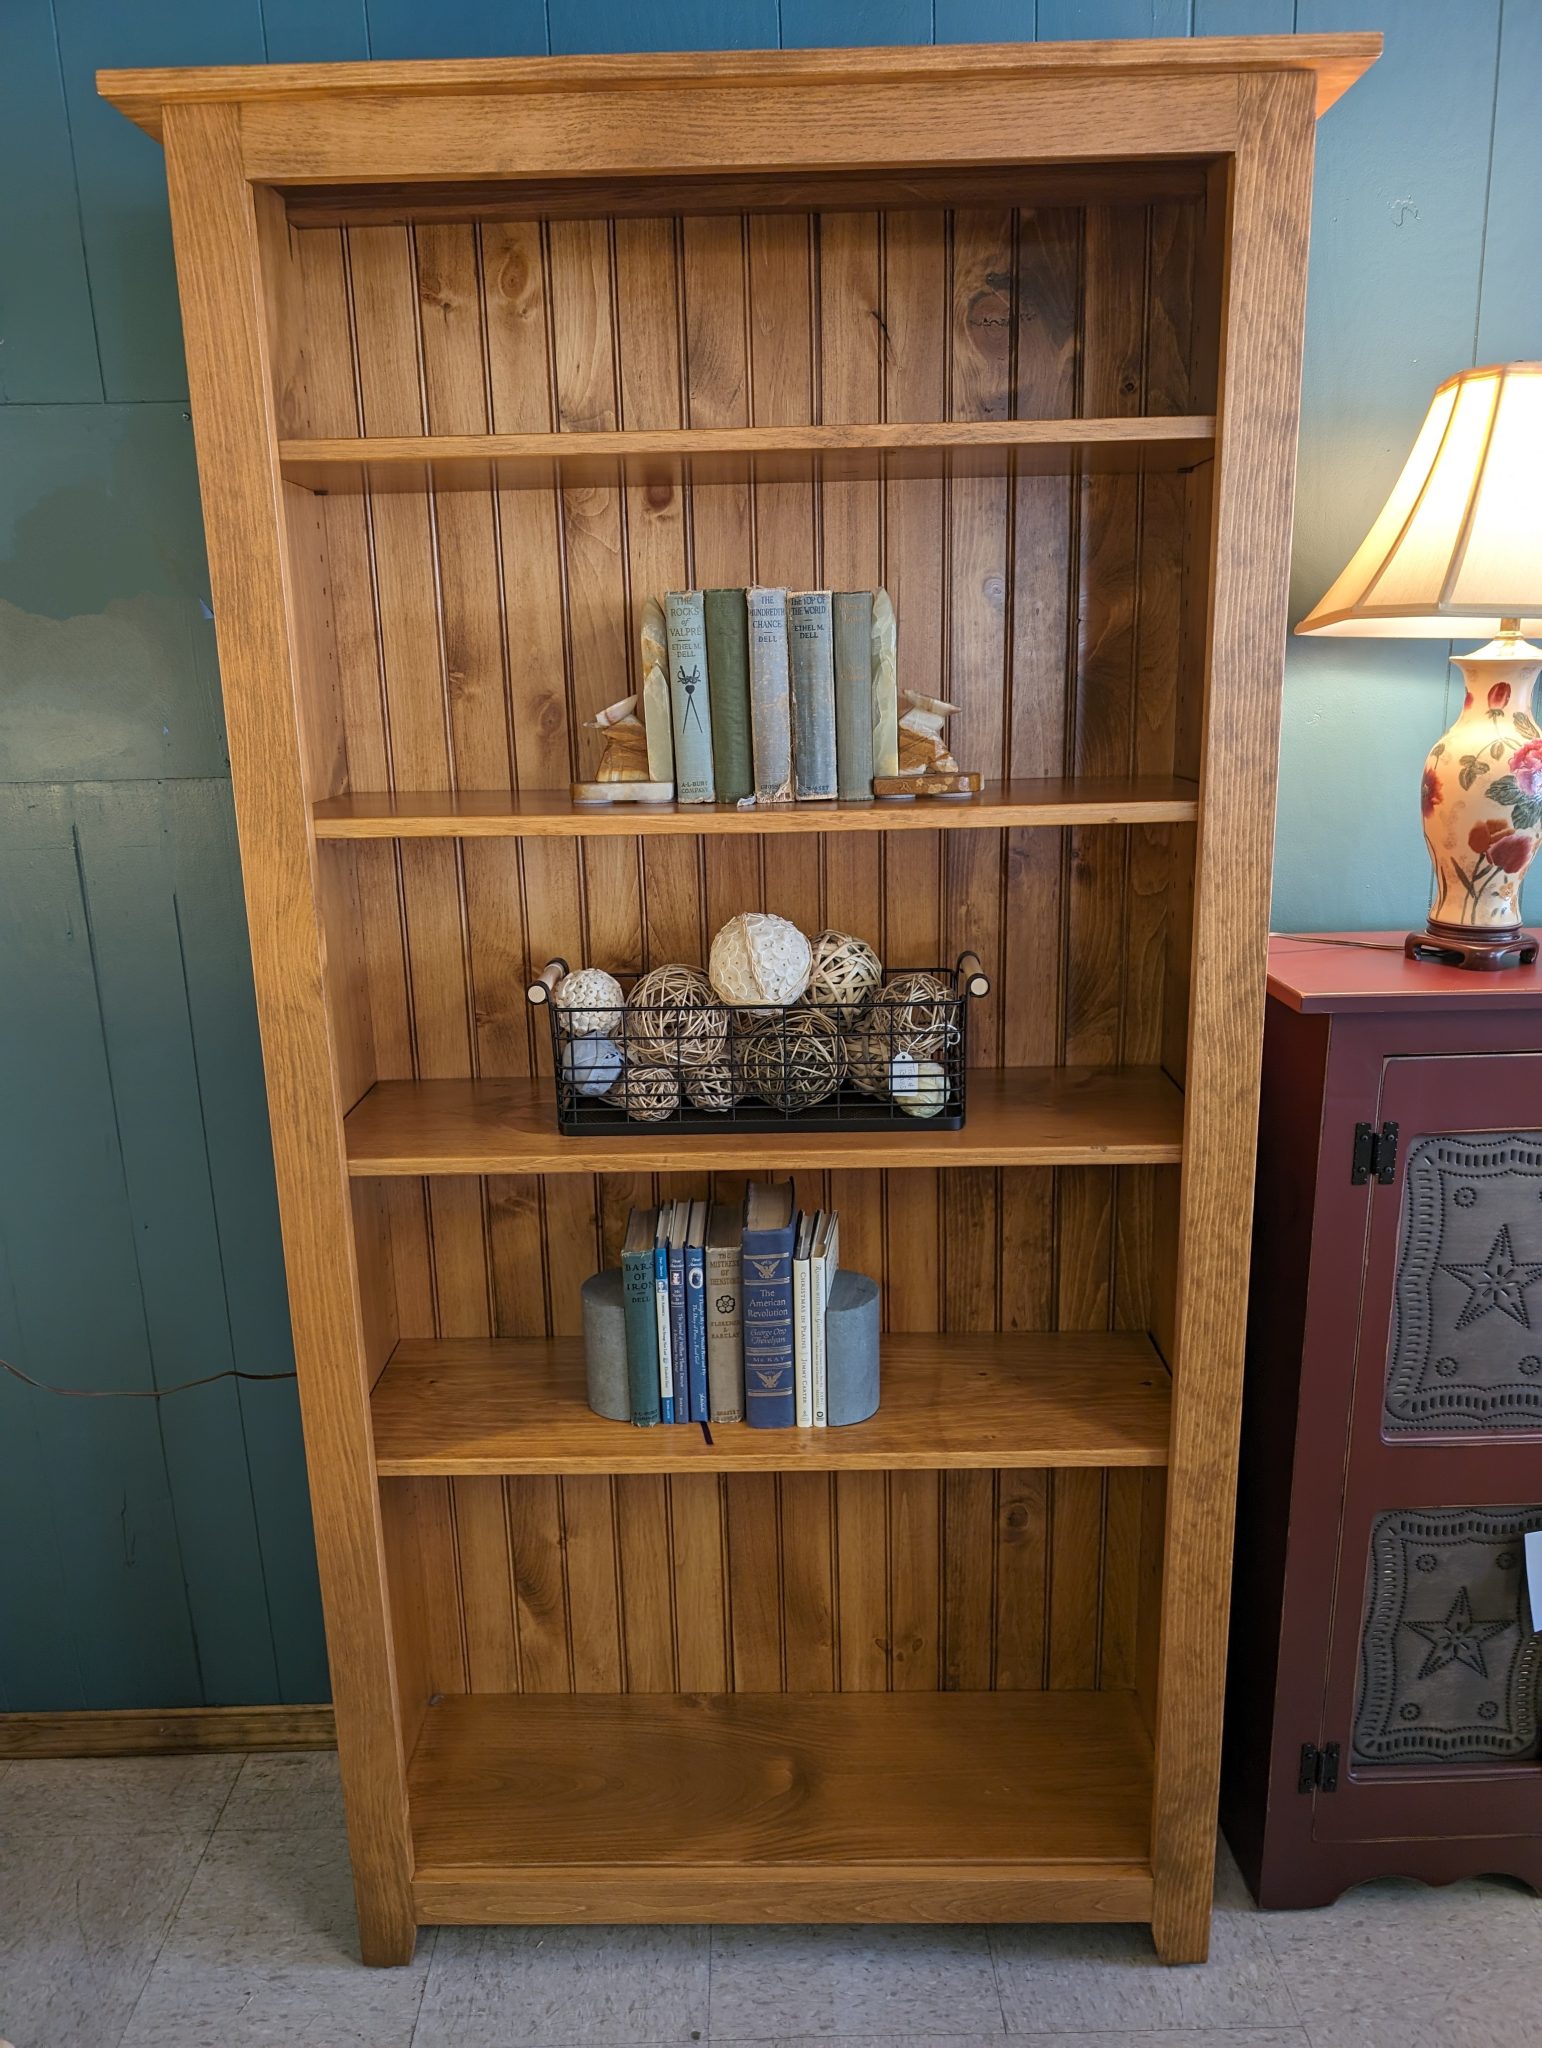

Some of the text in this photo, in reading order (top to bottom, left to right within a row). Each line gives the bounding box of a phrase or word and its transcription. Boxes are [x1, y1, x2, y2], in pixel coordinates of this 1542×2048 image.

[761, 596, 774, 605] THE
[803, 596, 816, 605] TOP
[816, 595, 826, 605] OF
[670, 607, 699, 617] ROCKS
[791, 605, 826, 616] THE WORLD
[681, 617, 691, 626] of
[752, 619, 782, 629] CHANCE
[794, 623, 825, 632] ETHEL M.
[758, 635, 778, 643] DELL
[671, 643, 692, 651] ETHEL
[625, 1262, 655, 1271] BARS
[633, 1272, 646, 1281] OF
[626, 1281, 655, 1290] IRON
[760, 1289, 775, 1297] The
[749, 1299, 786, 1308] American
[747, 1308, 788, 1318] Revolution
